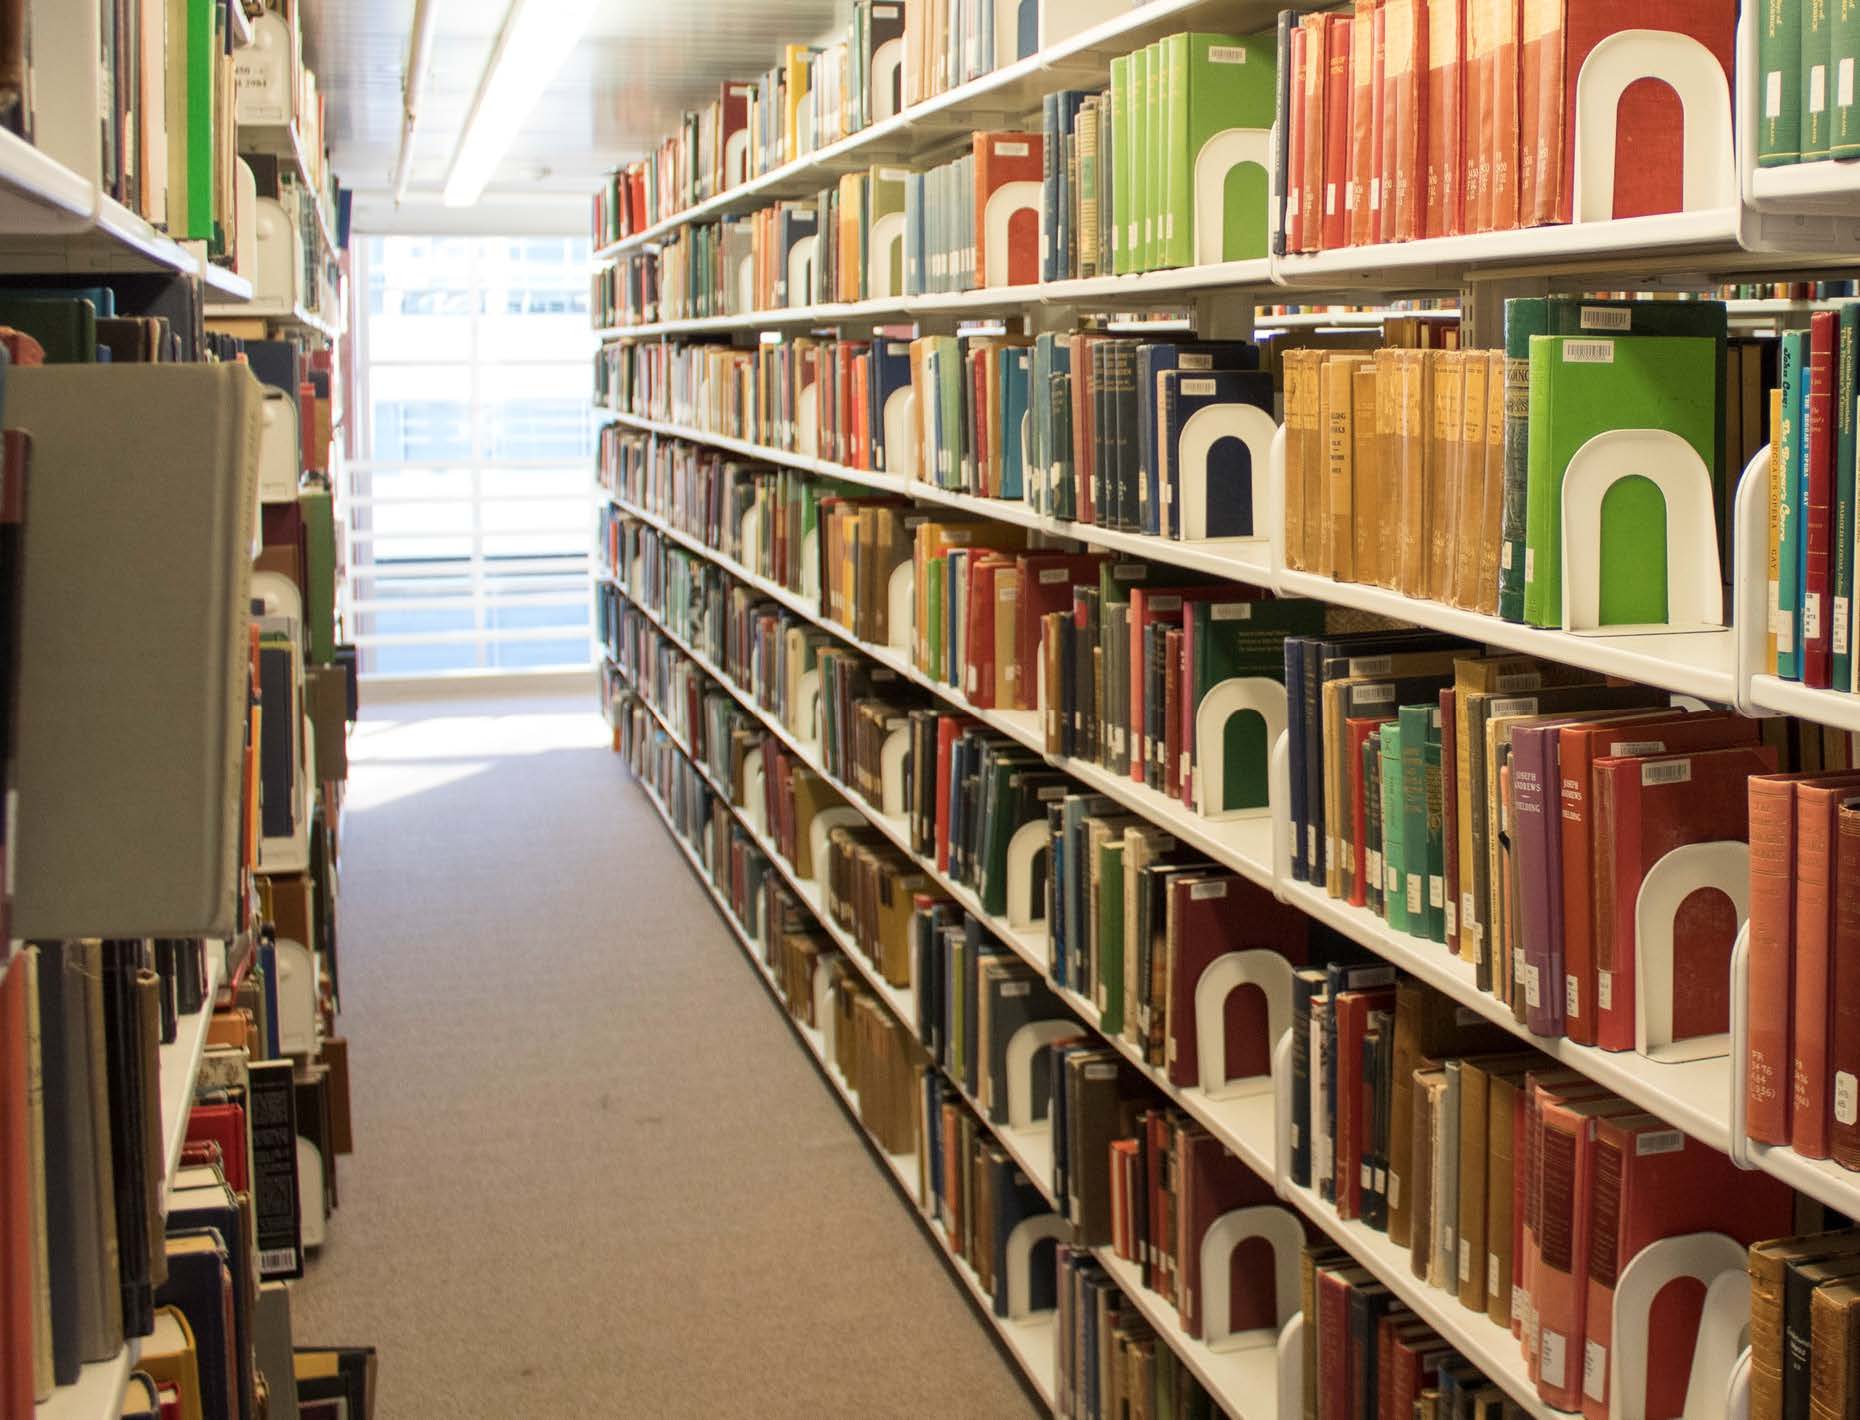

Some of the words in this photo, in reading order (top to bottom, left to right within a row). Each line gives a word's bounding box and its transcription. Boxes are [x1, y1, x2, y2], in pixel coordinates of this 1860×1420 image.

[1782, 347, 1791, 377] John
[1781, 419, 1791, 442] The
[1771, 440, 1779, 491] BEGGAR'S
[1770, 493, 1779, 530] OPERA
[1770, 549, 1778, 570] GAY
